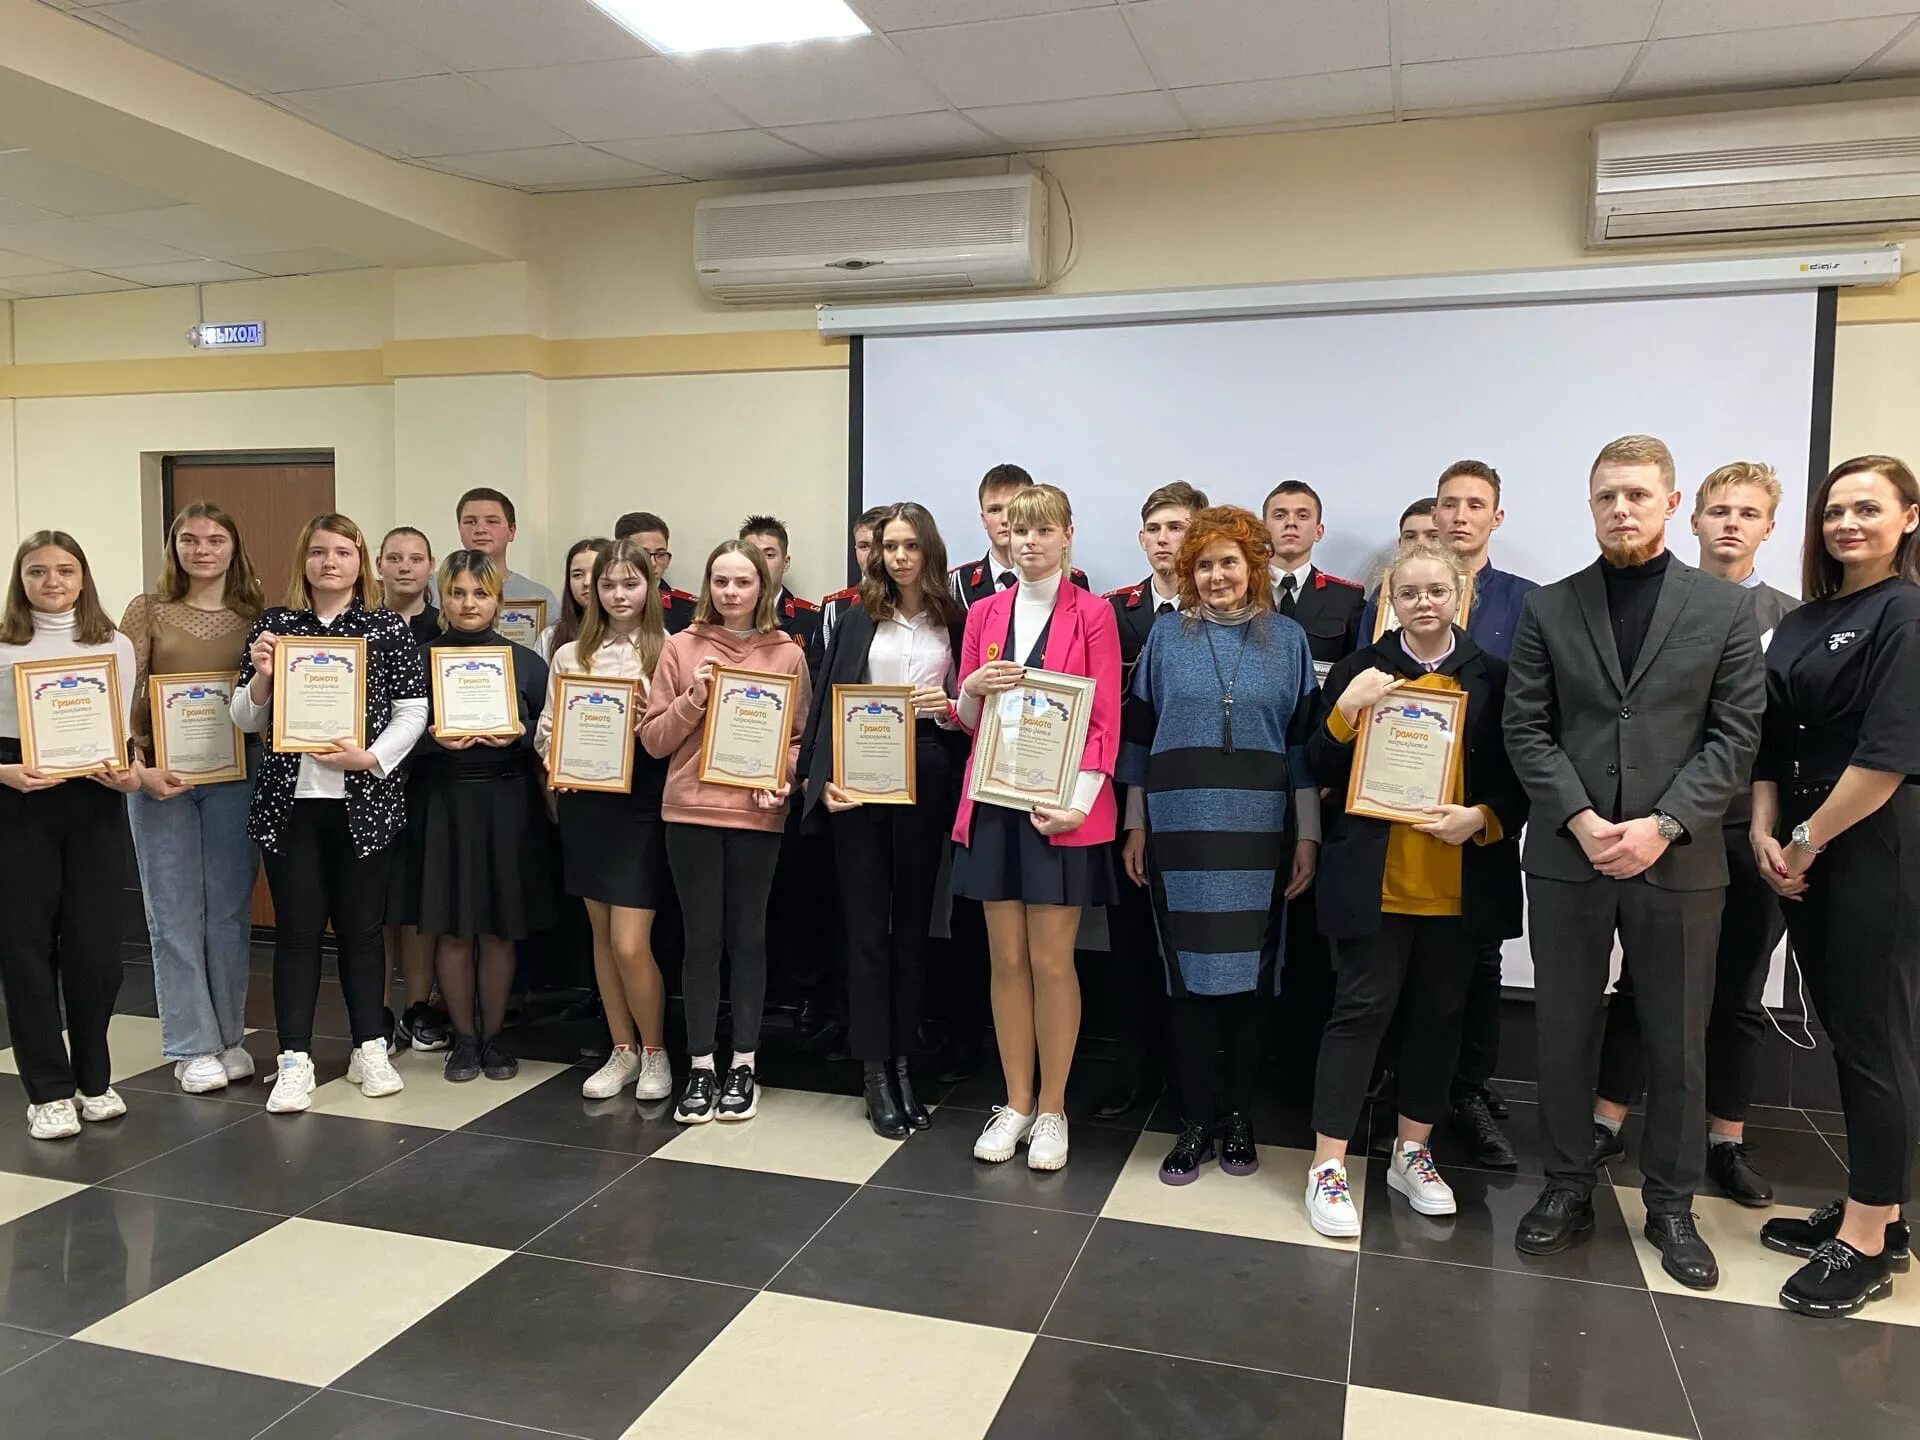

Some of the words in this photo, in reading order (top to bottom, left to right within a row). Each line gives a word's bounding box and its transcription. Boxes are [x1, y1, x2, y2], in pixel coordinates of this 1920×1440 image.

[304, 674, 339, 682] Грамота
[52, 698, 91, 709] Грамота
[181, 708, 216, 717] Грамота
[735, 706, 767, 718] Грамота
[860, 724, 891, 734] Грамота
[1390, 728, 1429, 741] Грамота
